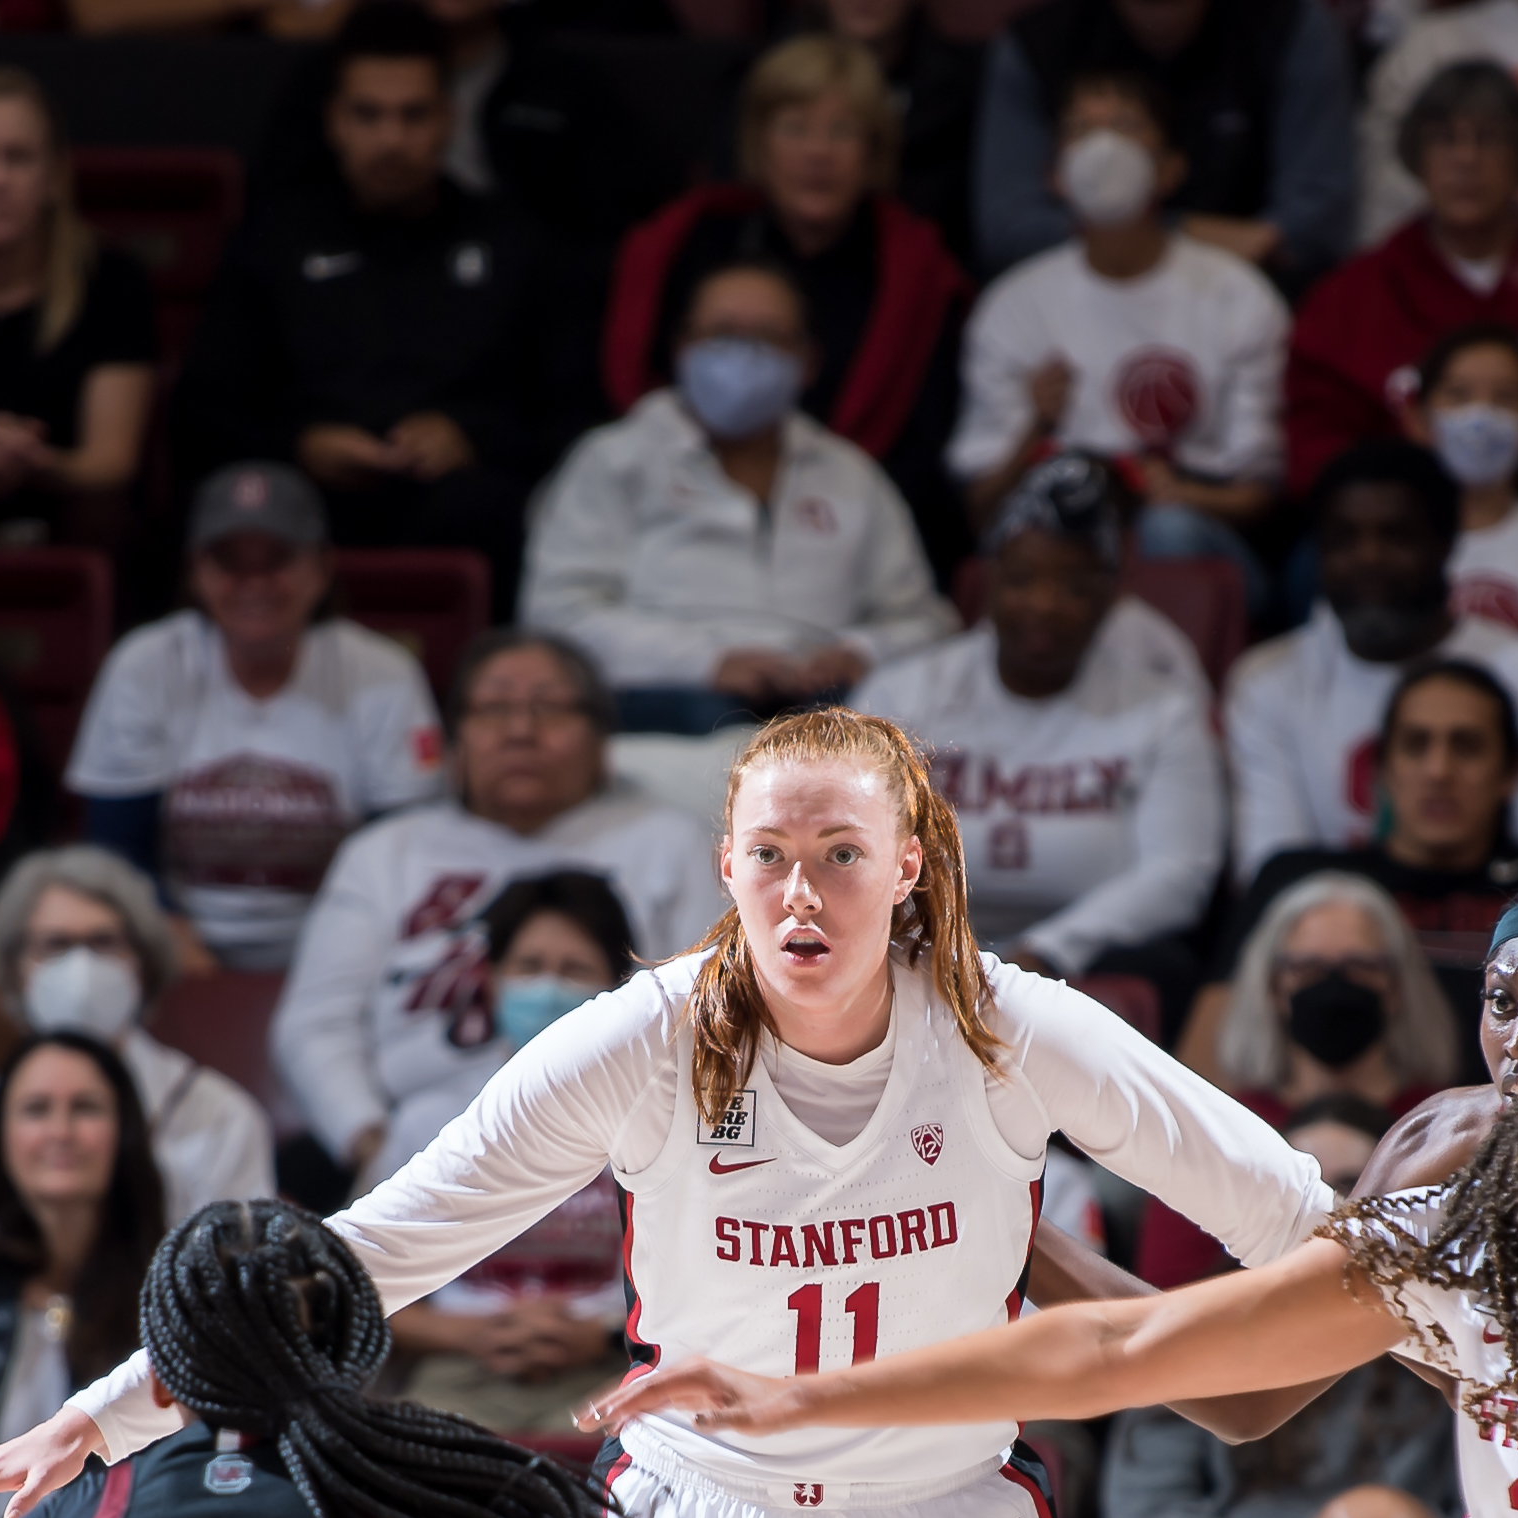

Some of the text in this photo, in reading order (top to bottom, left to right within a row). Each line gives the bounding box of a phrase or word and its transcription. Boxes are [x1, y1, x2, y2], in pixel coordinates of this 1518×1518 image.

[710, 1125, 741, 1139] BG
[911, 1124, 943, 1151] PAC
[920, 1141, 939, 1159] 12
[714, 1200, 959, 1268] STANFORD
[787, 1281, 880, 1377] 11
